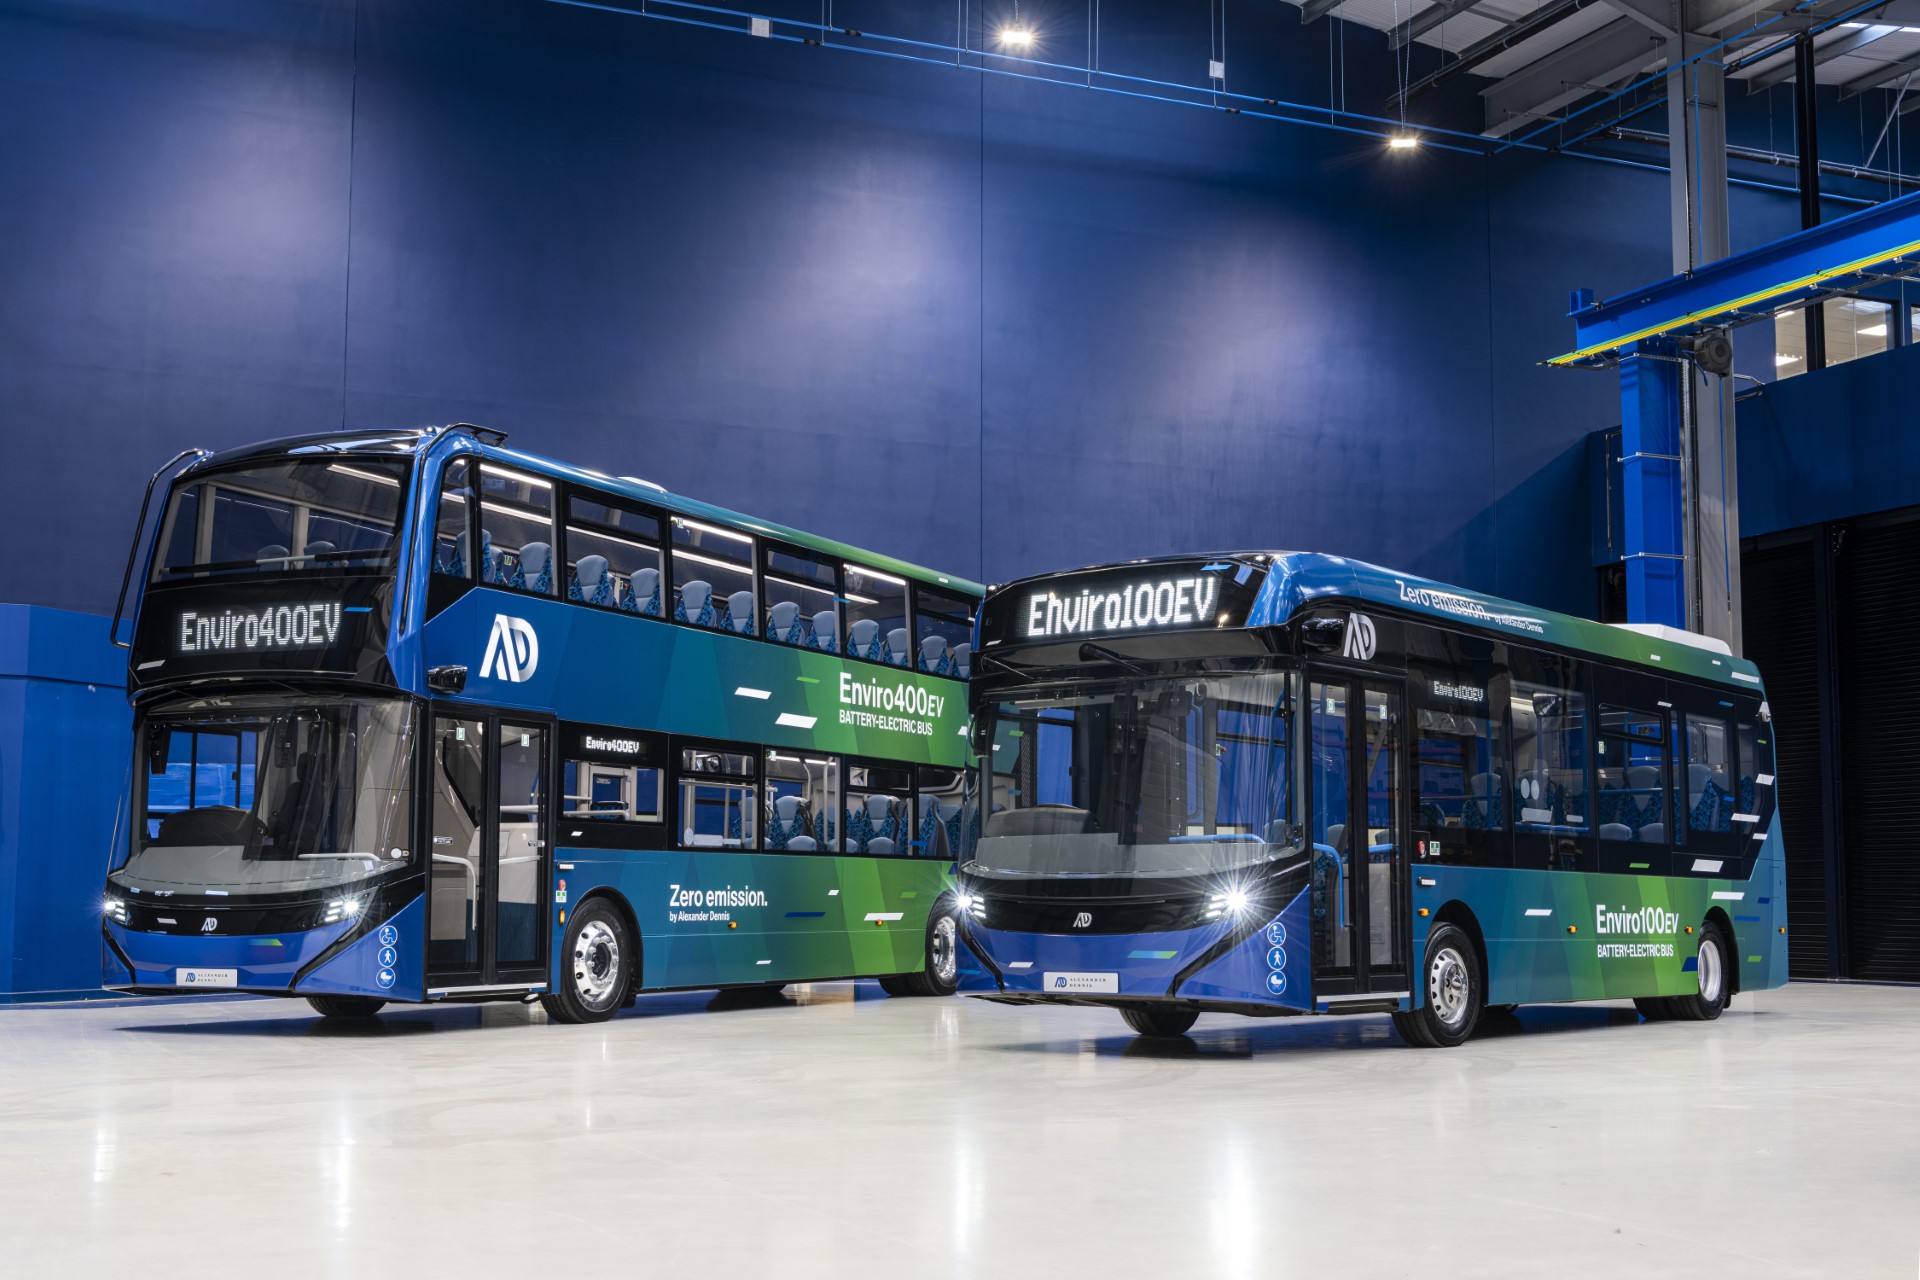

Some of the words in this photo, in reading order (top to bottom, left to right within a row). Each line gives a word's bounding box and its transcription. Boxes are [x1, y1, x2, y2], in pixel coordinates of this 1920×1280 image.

[1028, 577, 1215, 635] Enviro100EV
[1395, 579, 1430, 607] Zero
[1431, 593, 1490, 621] emission.
[181, 603, 340, 651] Enviro400EV
[839, 672, 945, 719] Enviro400EV
[839, 709, 917, 733] BATTERY-ELECTRIC
[917, 721, 933, 736] BUS
[585, 735, 640, 754] Enviro400EV
[669, 884, 703, 907] Zero
[705, 885, 768, 907] emission.
[669, 911, 677, 924] by
[678, 911, 709, 922] Alexander
[709, 910, 730, 921] Dennis
[1596, 904, 1679, 935] Enviro100EV
[1597, 943, 1660, 958] BATTERY-ELECTRIC
[1660, 944, 1674, 957] BUS
